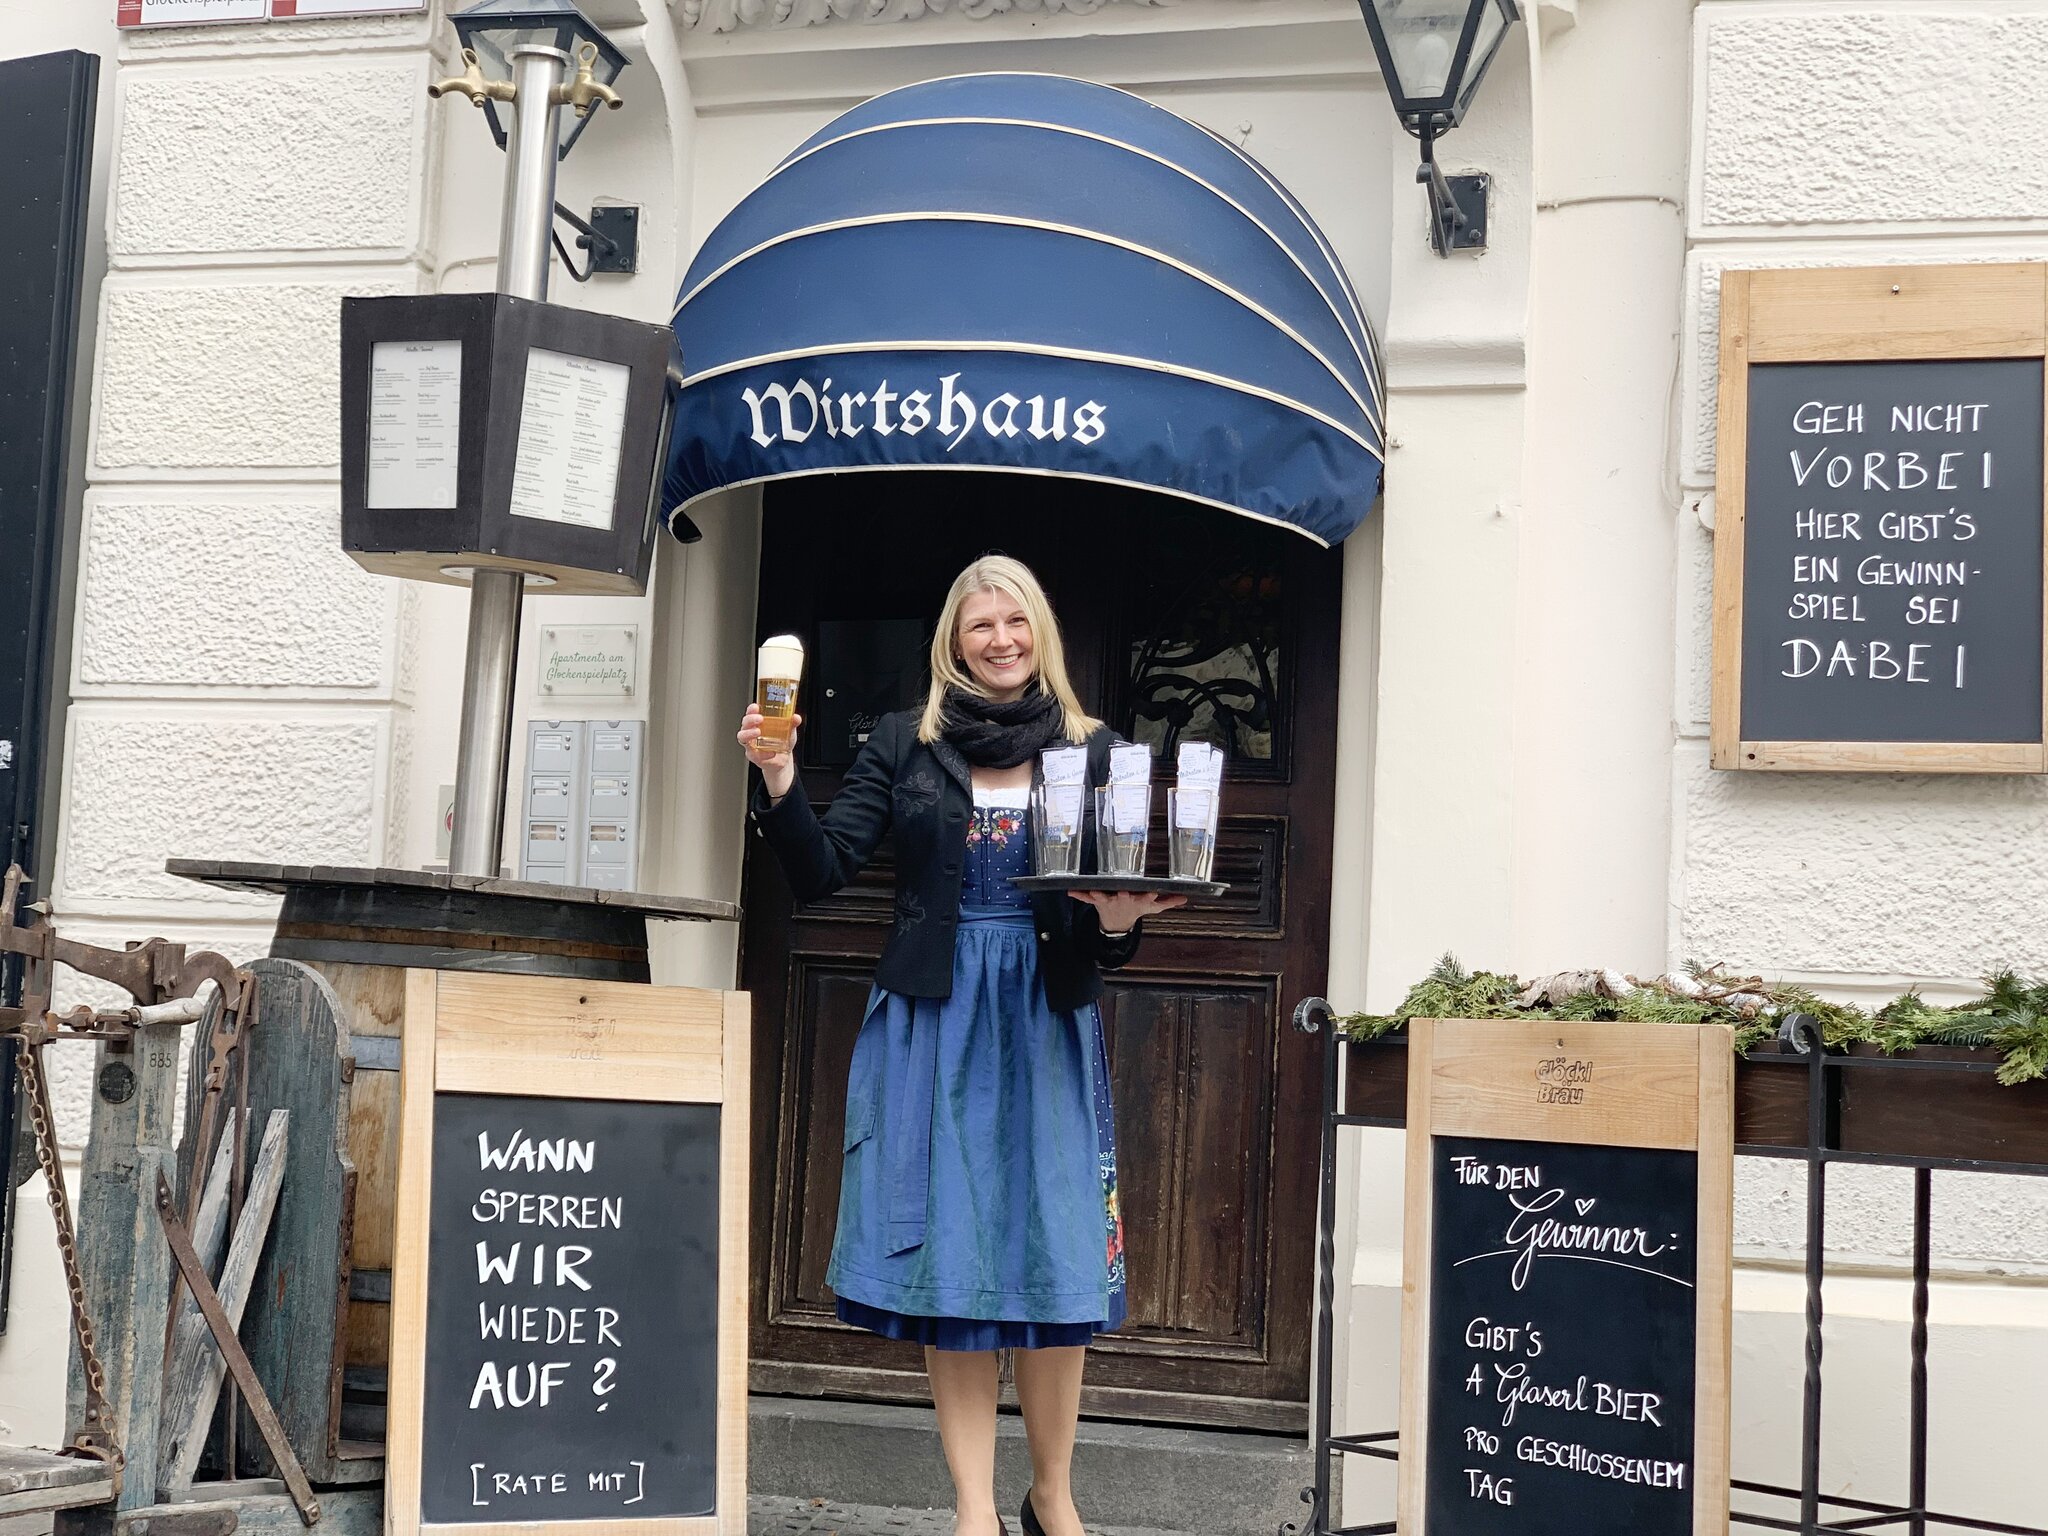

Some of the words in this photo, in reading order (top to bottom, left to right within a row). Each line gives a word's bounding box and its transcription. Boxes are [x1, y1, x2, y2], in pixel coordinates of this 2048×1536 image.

[741, 372, 1107, 452] Wirtshaus
[1792, 401, 1864, 435] GEH
[1890, 403, 1990, 434] NICHT
[1789, 446, 1992, 492] VORBEI
[1795, 507, 1862, 541] HIER
[1793, 555, 1839, 583] EIN
[1788, 592, 1866, 622] SPIEL
[1905, 595, 1959, 625] SEI
[546, 667, 628, 684] Glockenspielplatz
[550, 650, 606, 668] Apartments
[608, 655, 625, 663] am
[1781, 638, 1965, 689] DABEI
[849, 712, 880, 733] Glöck
[1535, 1057, 1593, 1083] Glöckl
[1537, 1080, 1584, 1105] Bräu
[478, 1128, 595, 1174] WANN
[1449, 1156, 1490, 1185] FÜR
[1495, 1164, 1540, 1190] DEN
[471, 1188, 622, 1229] SPERREN
[475, 1240, 593, 1292] WIR
[479, 1301, 622, 1347] WIEDER
[1465, 1363, 1484, 1396] A
[1494, 1362, 1589, 1427] Glaserl
[1592, 1382, 1662, 1427] BIER
[1463, 1426, 1499, 1455] PRO
[1516, 1435, 1684, 1490] GESCHLOSSENEM
[1463, 1468, 1513, 1506] TAG
